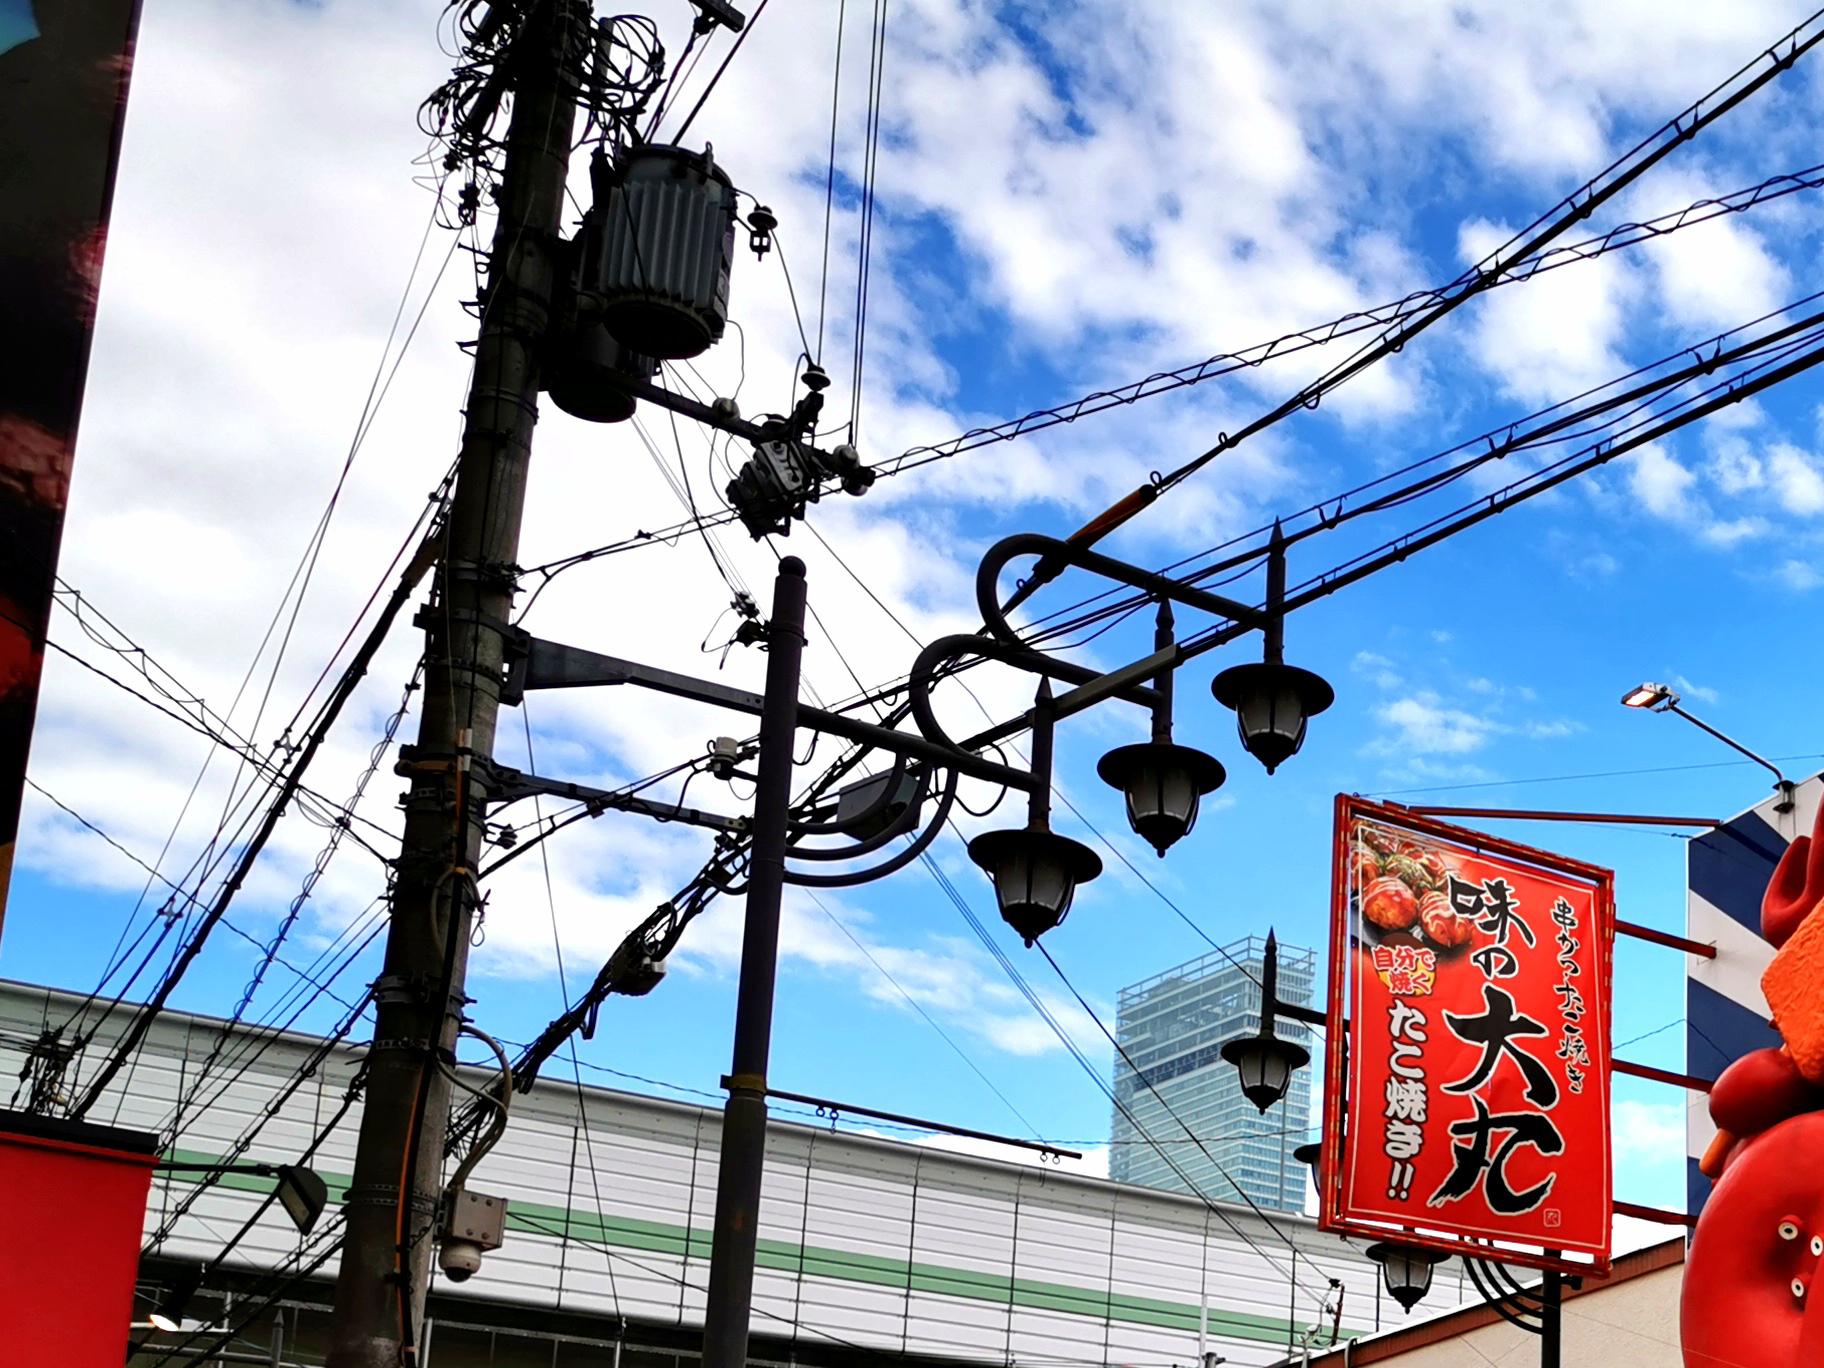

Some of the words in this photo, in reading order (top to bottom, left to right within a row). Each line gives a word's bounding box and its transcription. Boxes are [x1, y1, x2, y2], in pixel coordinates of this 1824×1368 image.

[1373, 946, 1437, 973] 自分で
[1388, 969, 1433, 996] 焼く
[1385, 999, 1429, 1201] たこ焼き!!
